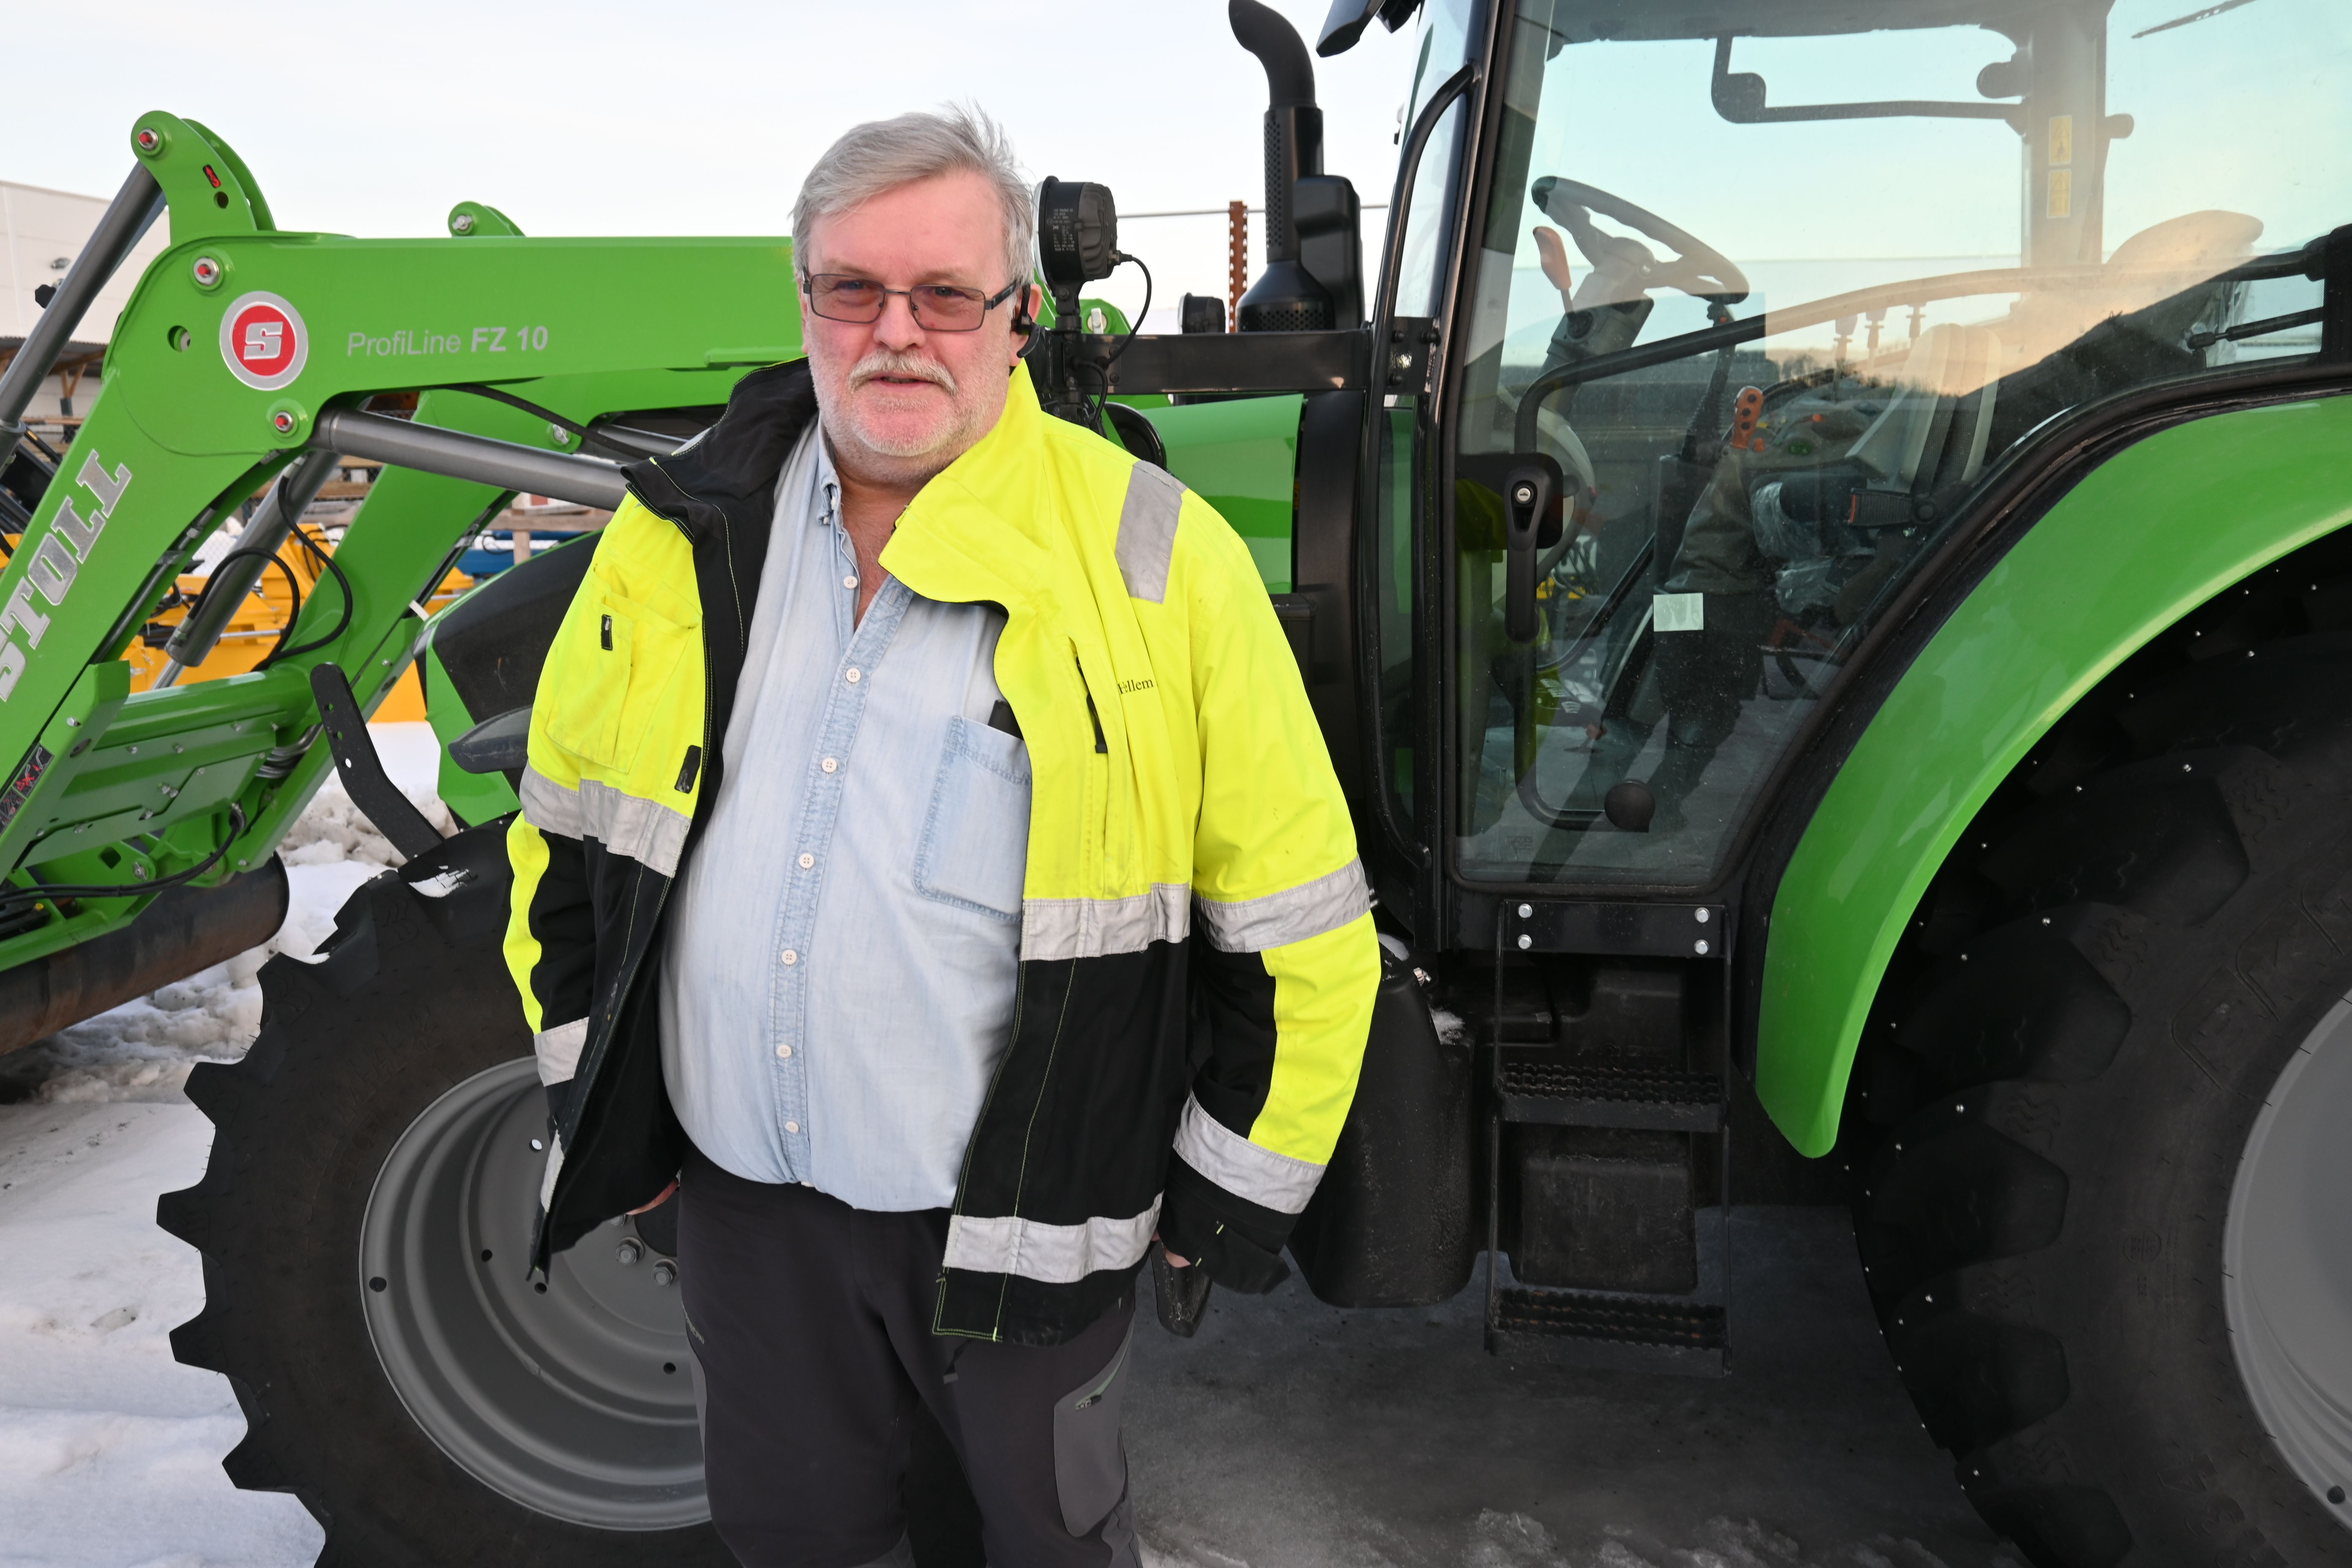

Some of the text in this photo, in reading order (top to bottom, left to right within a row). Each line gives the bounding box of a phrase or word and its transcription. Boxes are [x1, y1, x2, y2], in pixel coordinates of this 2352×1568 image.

[244, 321, 283, 360] S
[348, 326, 549, 357] ProfiLine FZ 10
